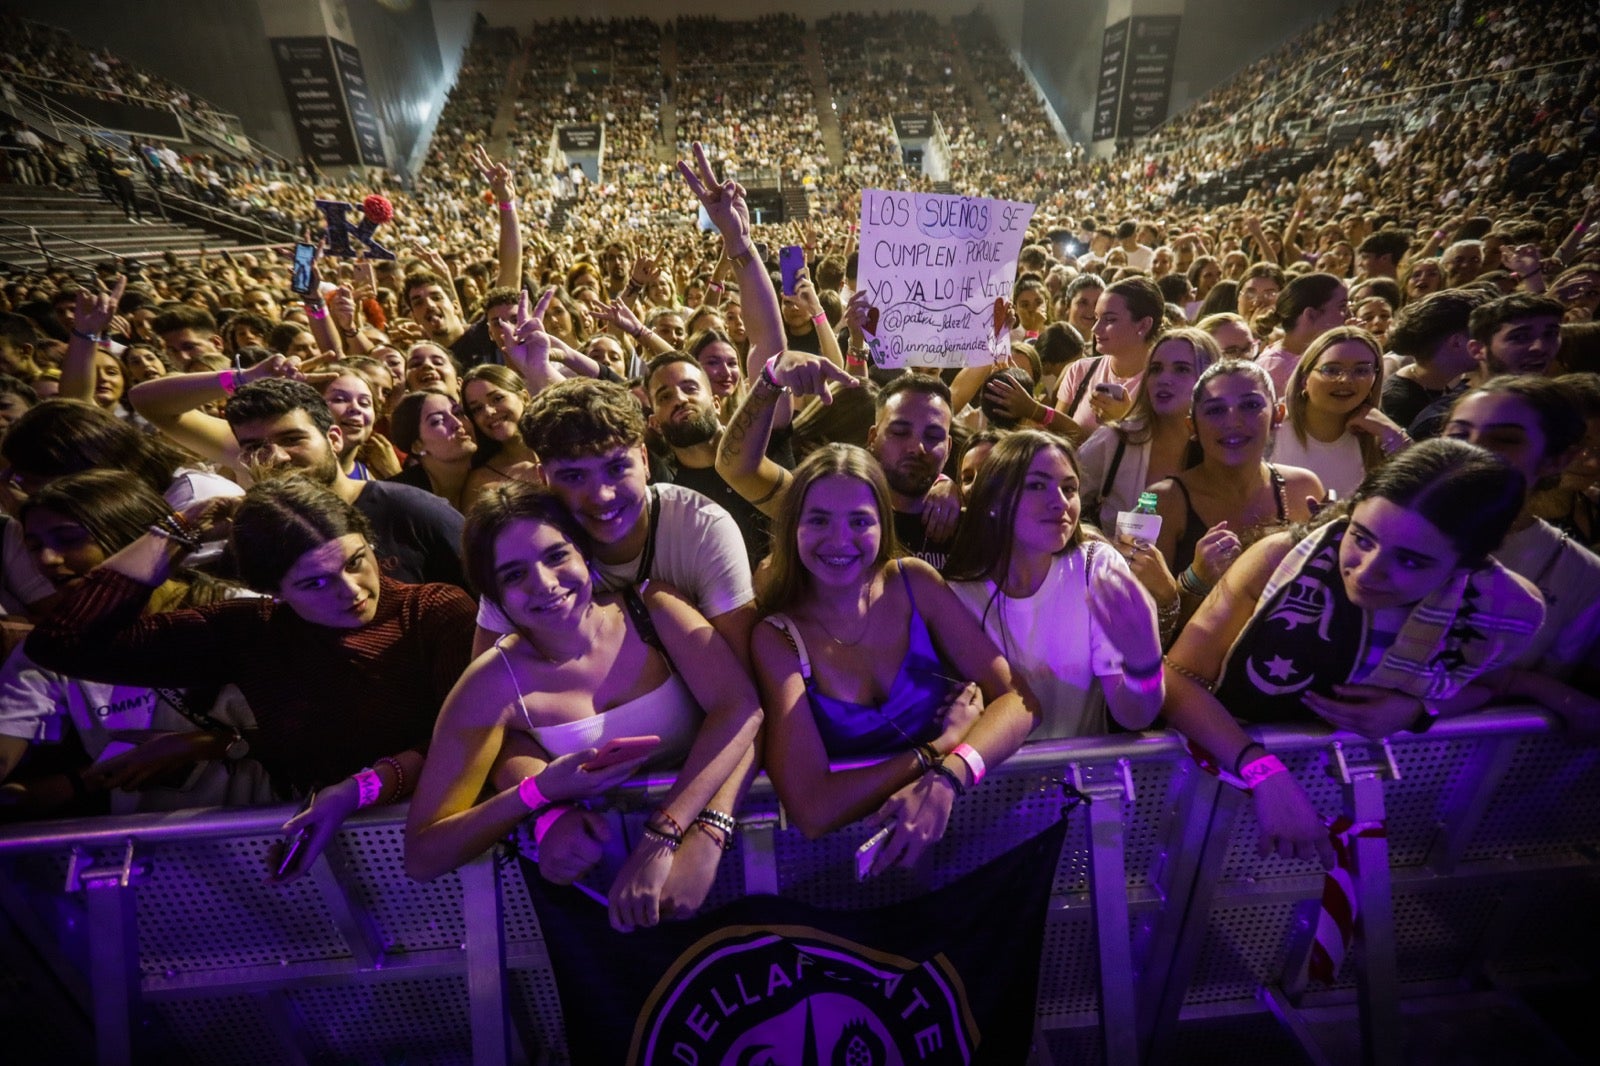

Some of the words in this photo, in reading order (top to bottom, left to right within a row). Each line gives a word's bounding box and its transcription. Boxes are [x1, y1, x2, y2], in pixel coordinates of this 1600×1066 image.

[869, 194, 910, 227] LOS
[923, 195, 988, 232] SUEÑOS
[1000, 206, 1024, 232] SE
[874, 240, 957, 269] CUMPLEN
[966, 239, 1003, 265] PORQUE
[867, 279, 893, 306] YO
[904, 279, 926, 302] YA
[935, 278, 954, 300] LO
[960, 276, 976, 302] HE
[94, 691, 154, 717] OMMY
